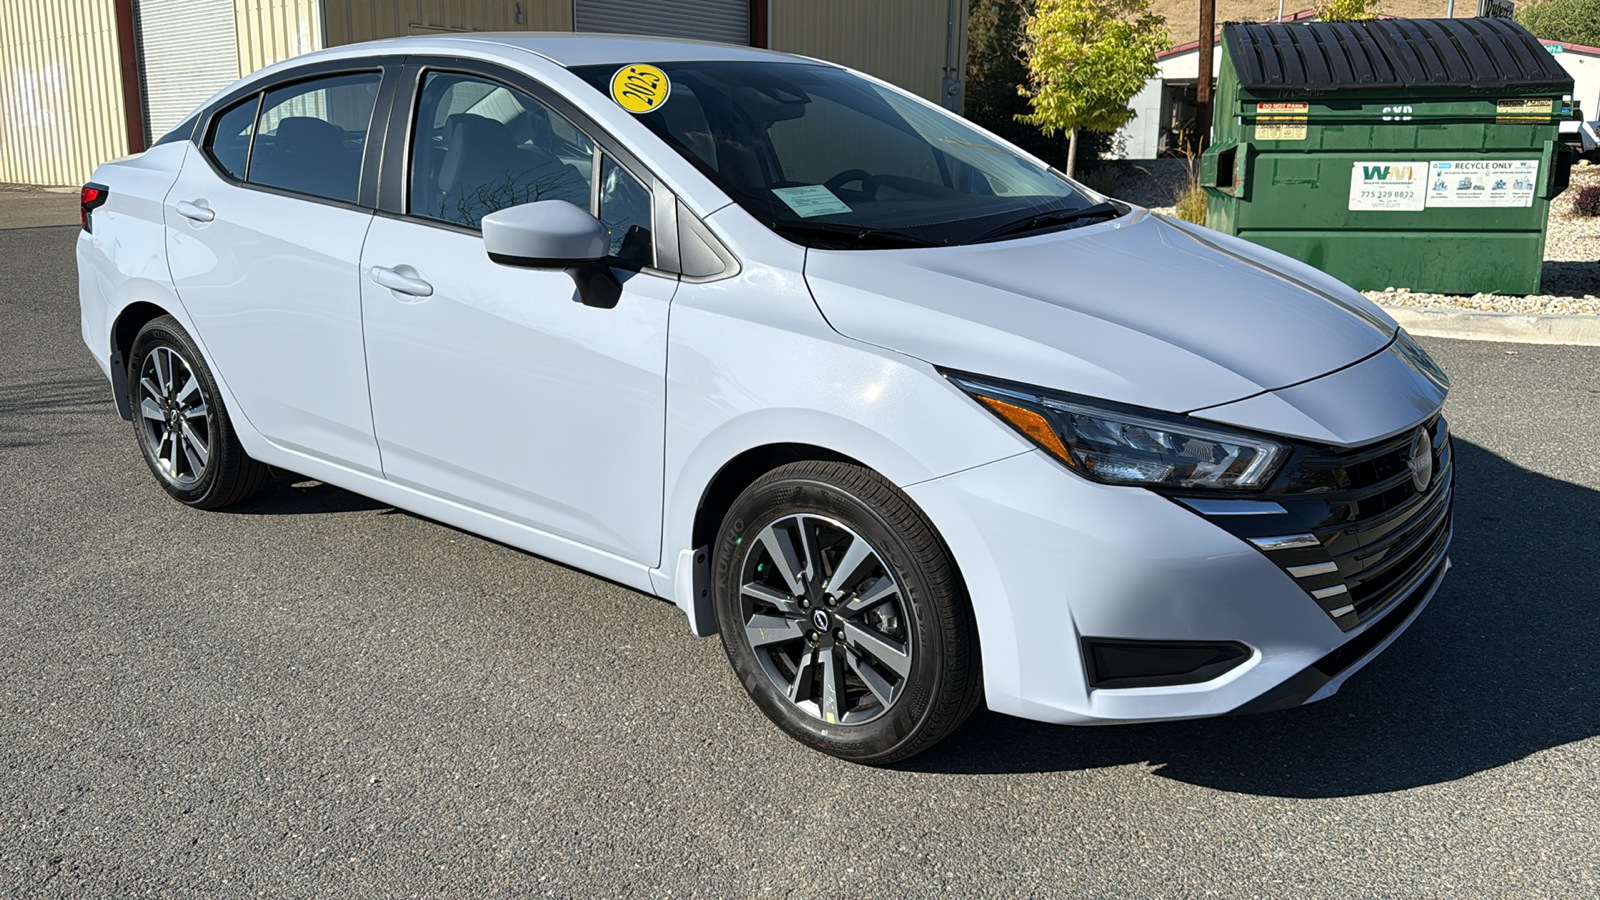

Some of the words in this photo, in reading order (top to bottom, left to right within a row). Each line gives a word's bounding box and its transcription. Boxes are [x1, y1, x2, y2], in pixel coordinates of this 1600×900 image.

[622, 67, 660, 106] 2025
[1362, 165, 1413, 181] WM
[1455, 162, 1490, 170] RECYCLE
[1408, 452, 1431, 471] NISS
[719, 518, 744, 588] KUMHO
[880, 540, 925, 620] SOLUS
[827, 740, 864, 751] 205/55
